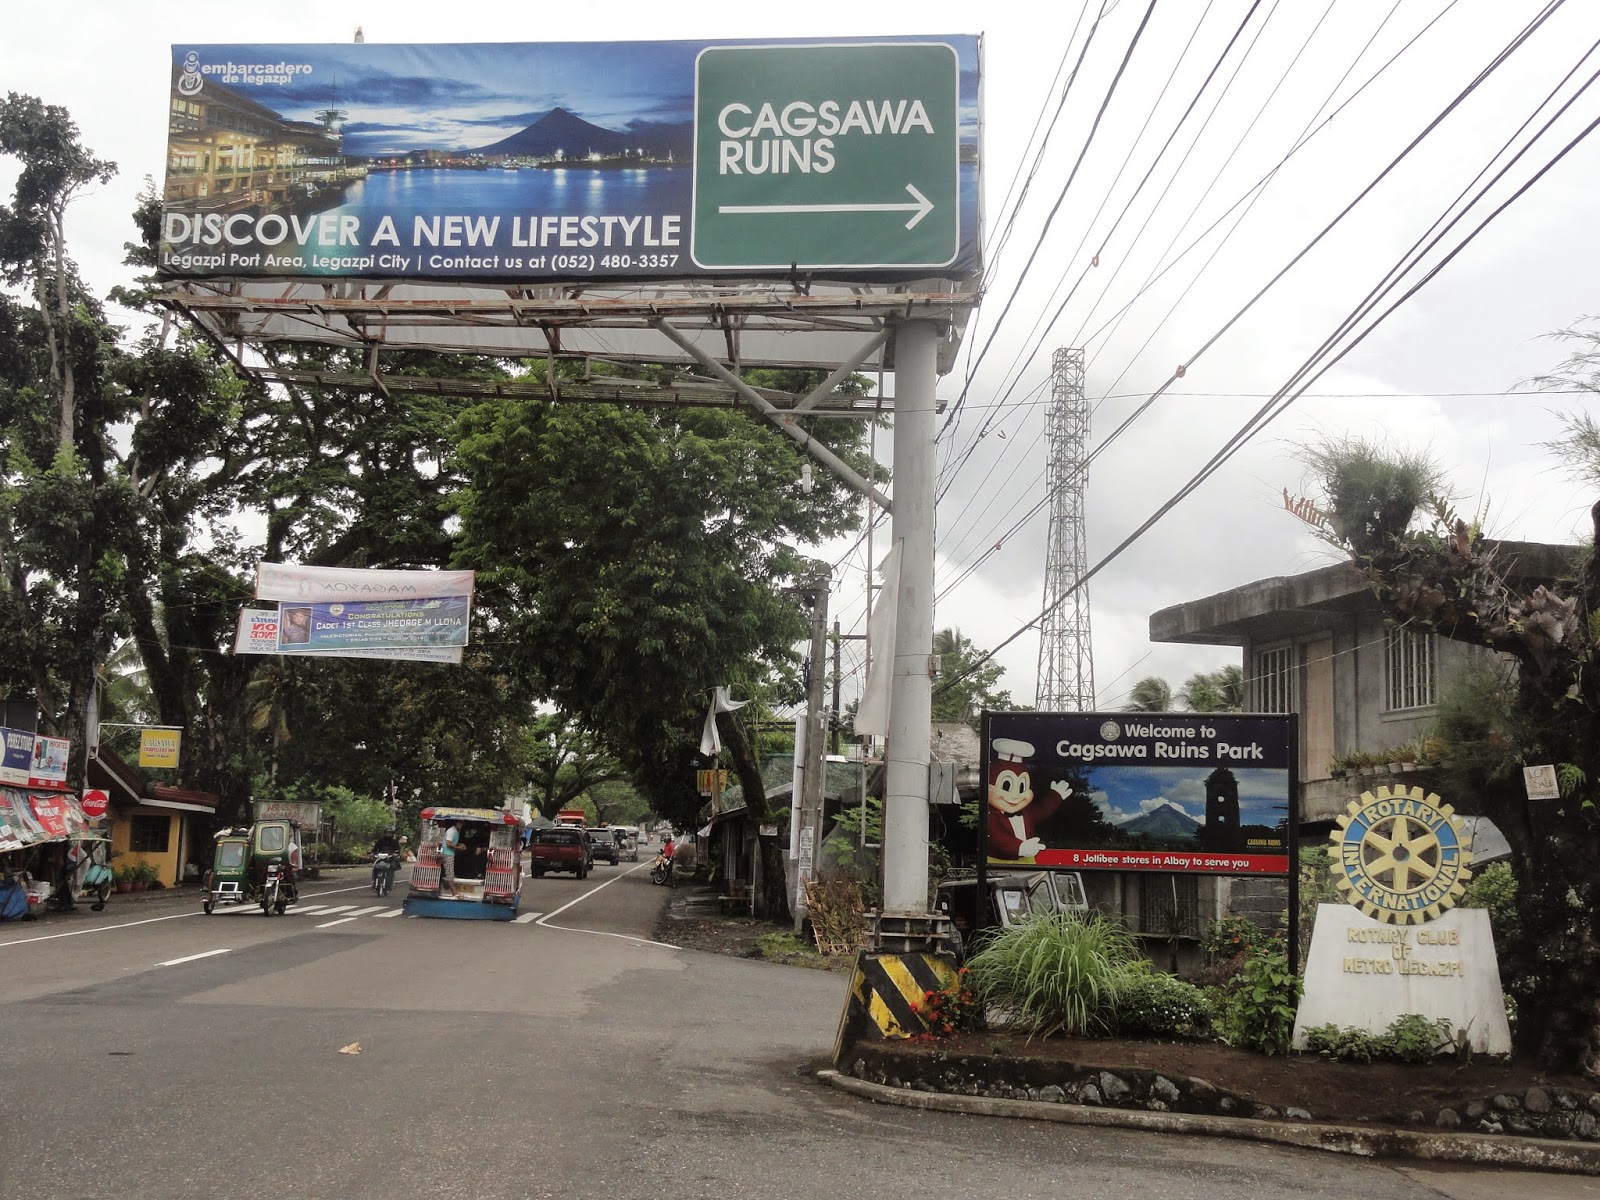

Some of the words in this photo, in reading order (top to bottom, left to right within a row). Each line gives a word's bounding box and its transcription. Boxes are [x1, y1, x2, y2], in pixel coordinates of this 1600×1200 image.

[201, 62, 313, 75] embarcadero
[222, 73, 239, 84] de
[243, 73, 292, 85] legazpi
[718, 100, 935, 139] CAGSAWA
[719, 138, 836, 175] RUINS
[165, 212, 360, 246] DISCOVER
[370, 215, 401, 247] A
[413, 215, 501, 247] NEW
[511, 215, 681, 248] LIFESTYLE
[163, 252, 226, 268] Legazpi
[230, 253, 260, 267] Port
[264, 254, 307, 269] Area,
[312, 254, 374, 270] Legazpi
[379, 254, 411, 270] City
[429, 254, 500, 269] Contact
[504, 258, 523, 269] us
[528, 255, 546, 269] at
[551, 254, 595, 272] (052)
[600, 254, 679, 268] 480-3357
[383, 618, 423, 628] JHEORGE
[424, 618, 432, 626] M
[434, 617, 462, 627] LLONA
[1124, 723, 1196, 738] Welcome
[1200, 725, 1216, 739] to
[1056, 740, 1147, 761] Cagsawa
[1154, 741, 1209, 759] Ruins
[1216, 742, 1264, 760] Park
[1362, 799, 1444, 828] ROTARY
[1073, 853, 1080, 863] 8
[1083, 853, 1119, 864] Jollibee
[1122, 855, 1150, 865] stores
[1152, 855, 1161, 865] in
[1164, 856, 1190, 868] Albay
[1193, 857, 1203, 867] to
[1205, 858, 1230, 867] serve
[1232, 860, 1250, 870] you
[1342, 845, 1460, 910] INTERNATIONAL
[1347, 927, 1409, 944] ROTARY
[1416, 929, 1460, 945] CLUB
[1391, 943, 1412, 961] OF
[1343, 957, 1394, 975] METRO
[1398, 959, 1465, 978] LEGAZPI
